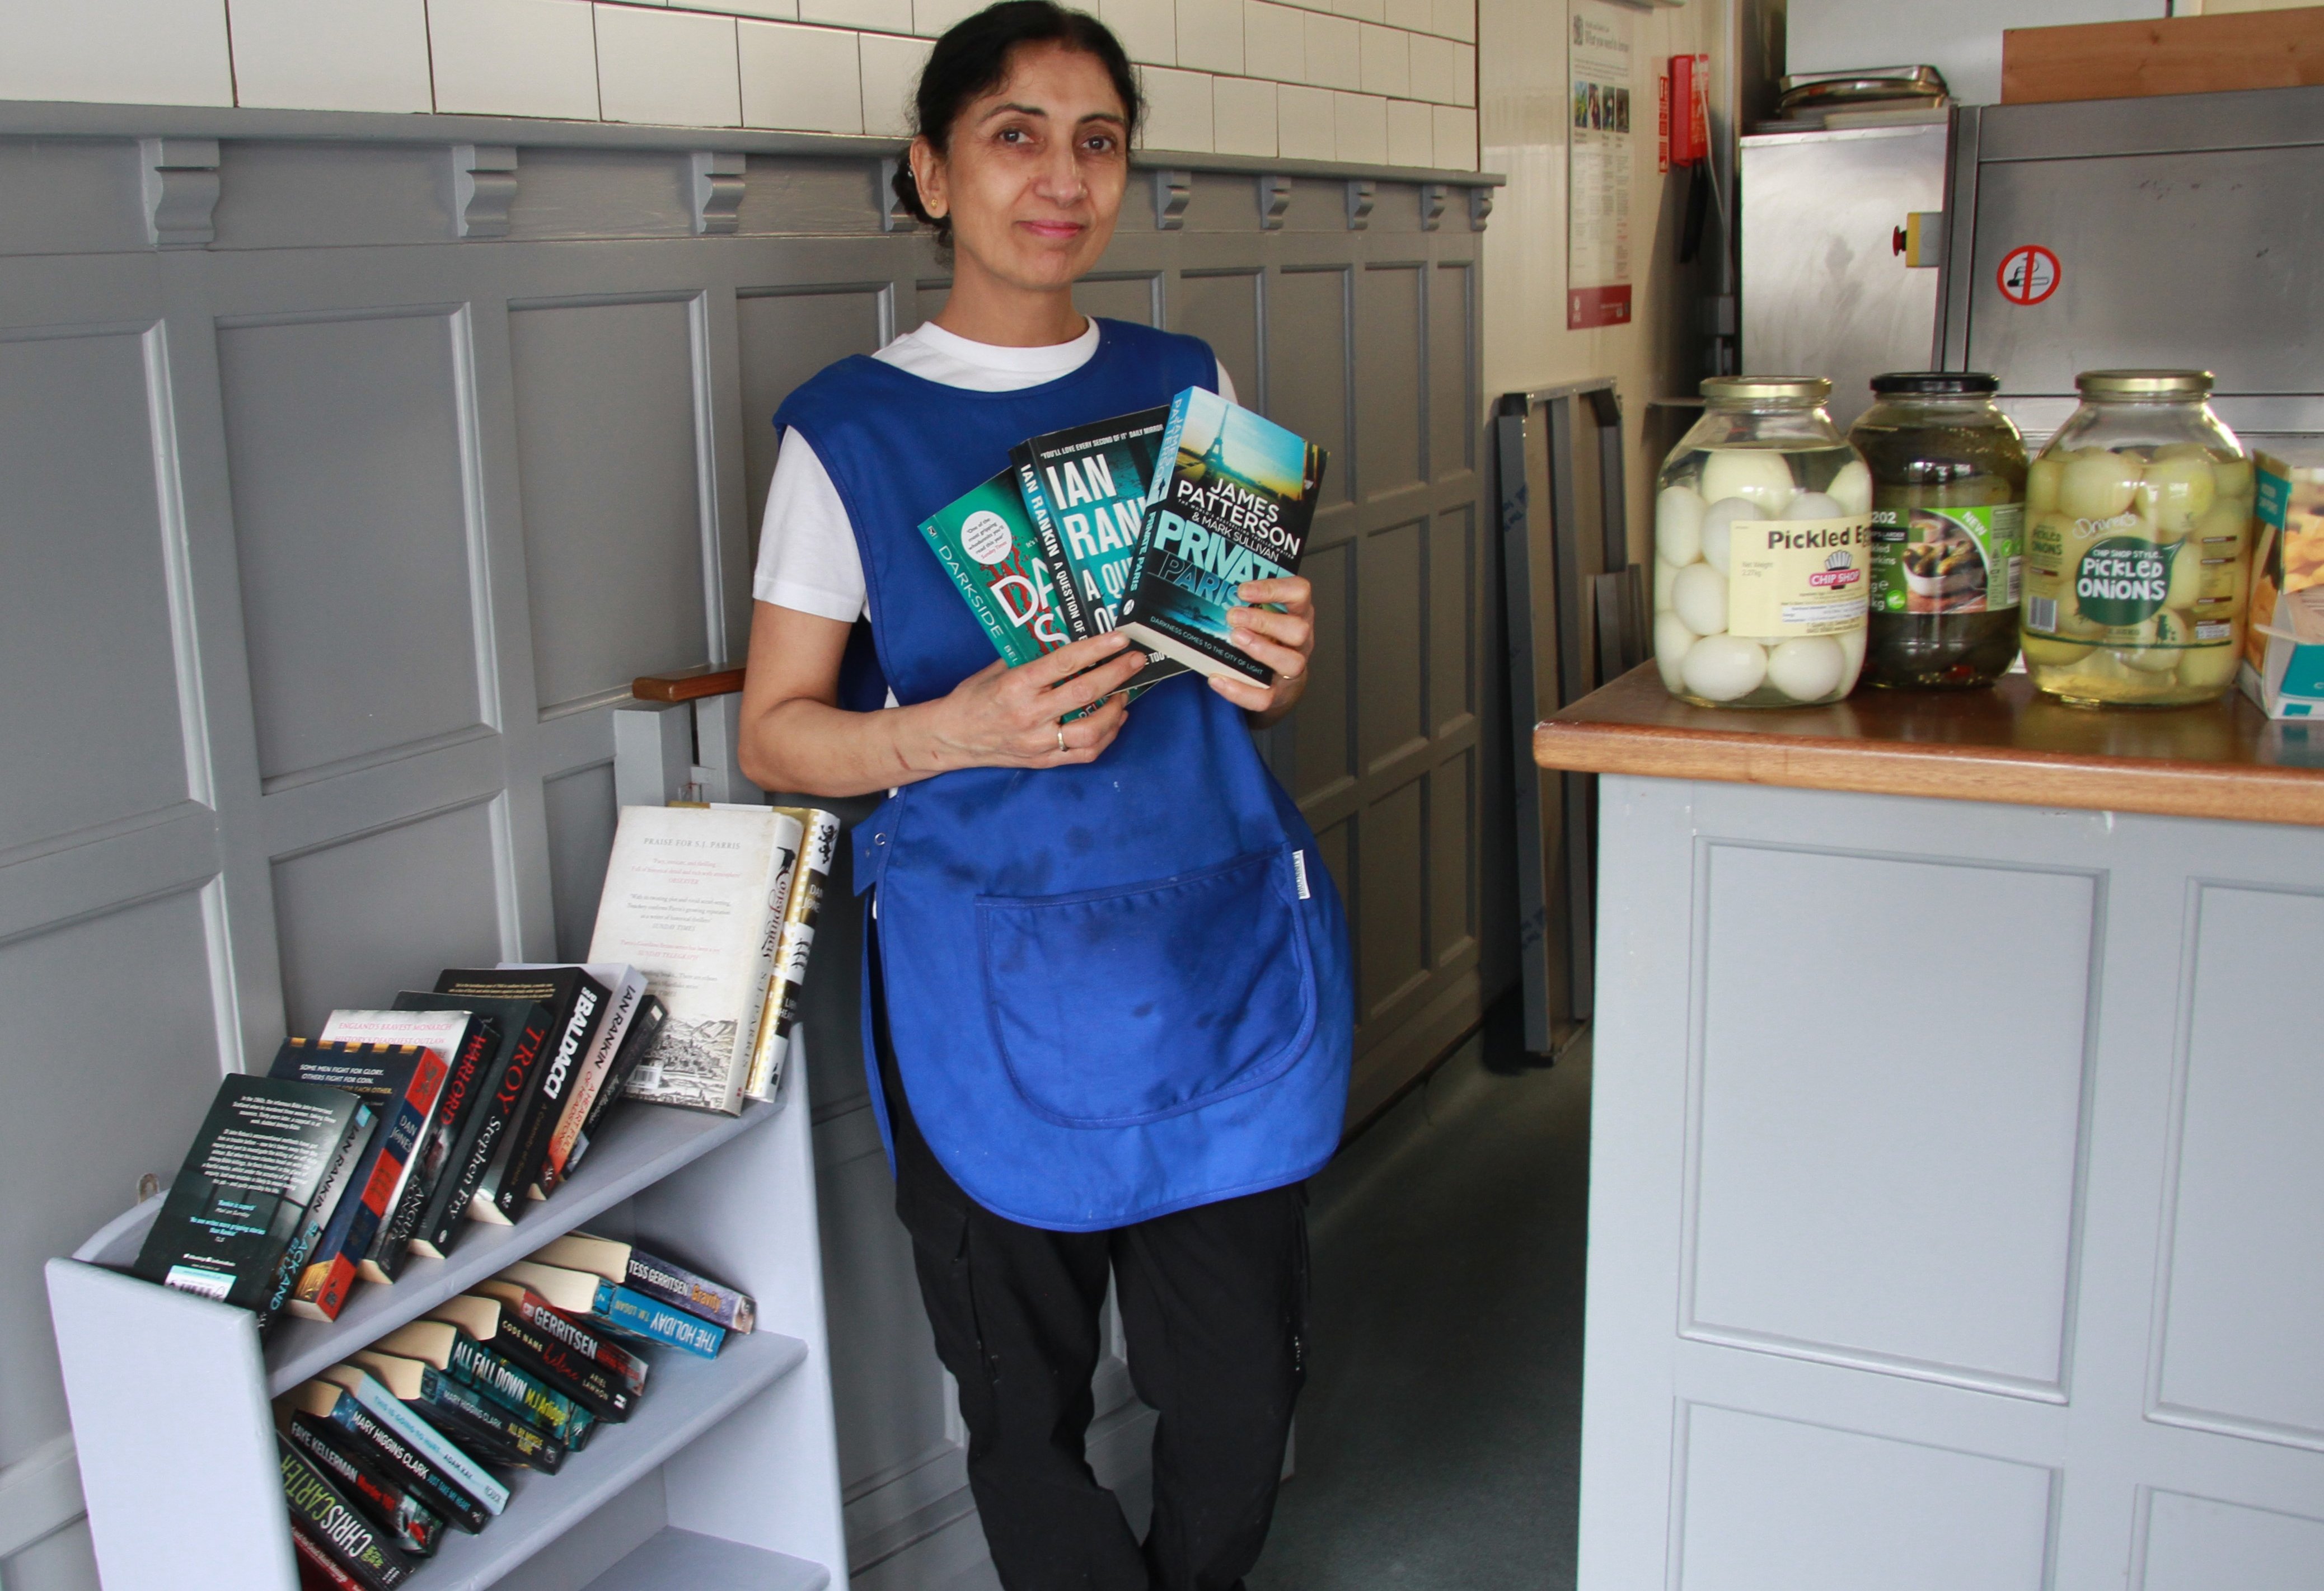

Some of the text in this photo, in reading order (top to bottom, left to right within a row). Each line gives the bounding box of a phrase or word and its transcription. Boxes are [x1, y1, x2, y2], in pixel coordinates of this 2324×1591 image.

[1062, 445, 1076, 454] LOVE
[1076, 440, 1092, 451] EVERY
[1092, 436, 1113, 447] SECOND
[1113, 433, 1120, 442] OF
[1128, 428, 1144, 438] DAILY
[1144, 424, 1164, 435] MIRROR
[1021, 464, 1038, 494] IAN
[1046, 453, 1117, 510] IAN
[1210, 478, 1280, 523] JAMES
[1031, 495, 1060, 557] RANKIN
[1063, 496, 1146, 560] RAN
[1177, 480, 1300, 555] PATTERSON
[1191, 511, 1280, 562] & MARK SULLIVAN
[1768, 527, 1850, 549] Pickled
[1962, 511, 1986, 536] NEW
[1054, 562, 1063, 570] A
[1130, 511, 1157, 592] PRIVATE PARIS
[2110, 549, 2131, 558] SHOP
[939, 545, 1004, 639] DARKSIDE
[1056, 571, 1079, 620] QUESTION
[1082, 557, 1133, 602] A QU
[1159, 553, 1241, 611] PARIS
[1811, 570, 1860, 585] CHIP SHOP
[1073, 621, 1085, 633] OF
[1150, 616, 1264, 675] DARKNESS COMES TO THE CITY OF LIGHT
[643, 838, 674, 846] PRAISE
[709, 841, 741, 850] PARRIS
[619, 985, 636, 1013] IAN
[339, 1022, 452, 1031] ENGLAND'S BRAVEST MONARCH
[414, 1037, 446, 1045] OUTLAW
[543, 994, 595, 1100] BALDACCI
[594, 1014, 624, 1069] RANKIN
[299, 1063, 316, 1072] SOME
[301, 1073, 325, 1081] OTHERS
[439, 1034, 487, 1125] WARLORD
[496, 1026, 545, 1115] TROY
[390, 1126, 413, 1153] JONES
[400, 1115, 418, 1135] DAN
[313, 1125, 359, 1213] IAN RANKIN
[449, 1115, 501, 1220] Stephen Fry
[399, 1187, 425, 1241] ANGUS
[270, 1219, 319, 1310] BLACK AND
[629, 1259, 723, 1313] TESS GERRITSEN Gravity
[502, 1320, 543, 1353] CODE NAME
[534, 1307, 598, 1359] GERRITSEN
[638, 1312, 649, 1322] TIM
[650, 1311, 717, 1352] THE HOLIDAY
[453, 1341, 474, 1370] ALL
[471, 1352, 496, 1385] FALL
[494, 1367, 528, 1402] DOWN
[582, 1379, 609, 1401] LAWHON
[589, 1373, 607, 1388] ARIEL
[443, 1389, 503, 1430] MARY HIGGINS CLARK
[291, 1421, 358, 1484] FAYE KELLERMAN
[351, 1410, 376, 1435] MARY
[373, 1427, 405, 1461] HIGGINS
[402, 1452, 430, 1481] CLARK
[443, 1454, 461, 1471] ADAM
[280, 1454, 336, 1520] CARTER
[320, 1505, 373, 1557] CHRIS
